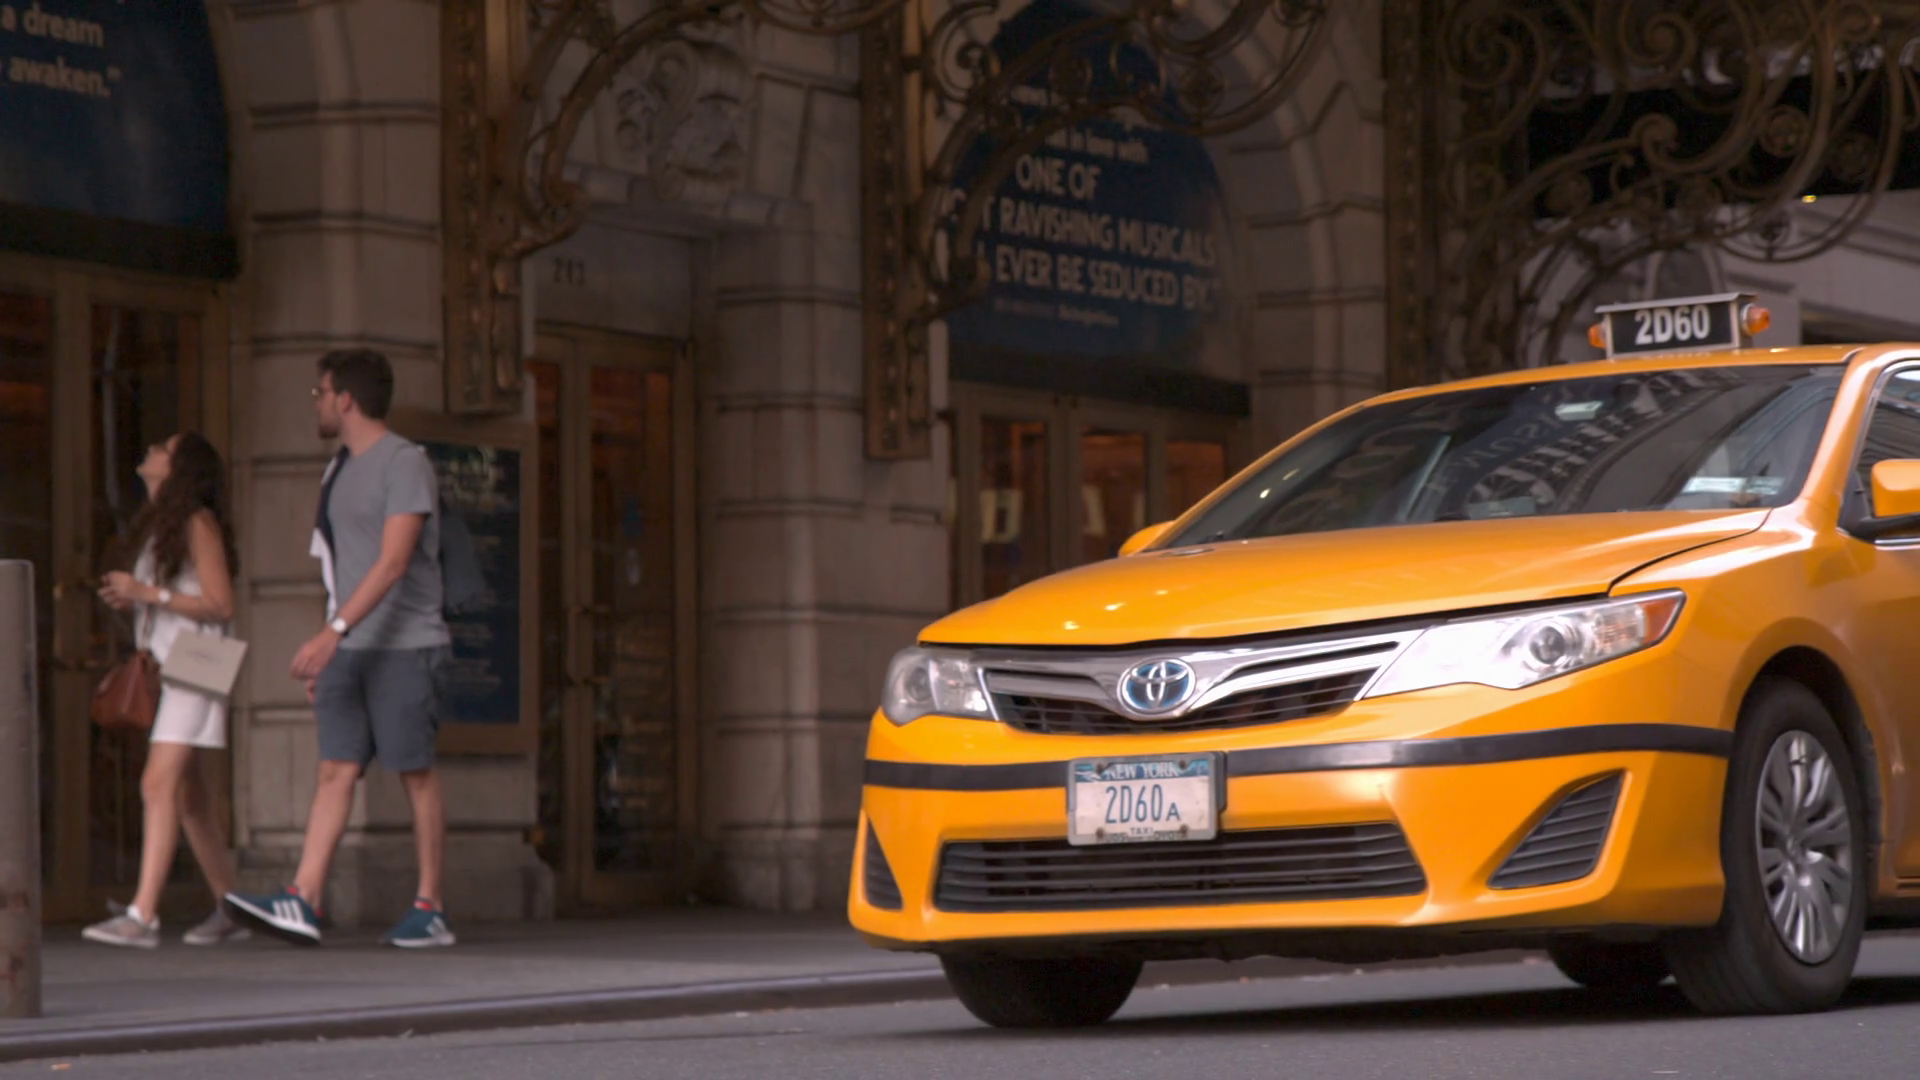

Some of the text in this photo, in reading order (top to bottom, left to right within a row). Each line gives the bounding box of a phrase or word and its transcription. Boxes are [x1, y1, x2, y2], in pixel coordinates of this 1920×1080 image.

[23, 2, 105, 48] dream
[1015, 153, 1101, 201] ONE OF
[1000, 197, 1115, 250] RAVISHING
[1118, 217, 1217, 268] MUSICALS
[996, 244, 1052, 289] EVER
[1057, 254, 1085, 293] BE
[1088, 259, 1180, 307] SEDUCED
[1635, 304, 1710, 345] 2D60
[1104, 762, 1179, 780] NEW YORK
[1130, 827, 1154, 836] TAXI
